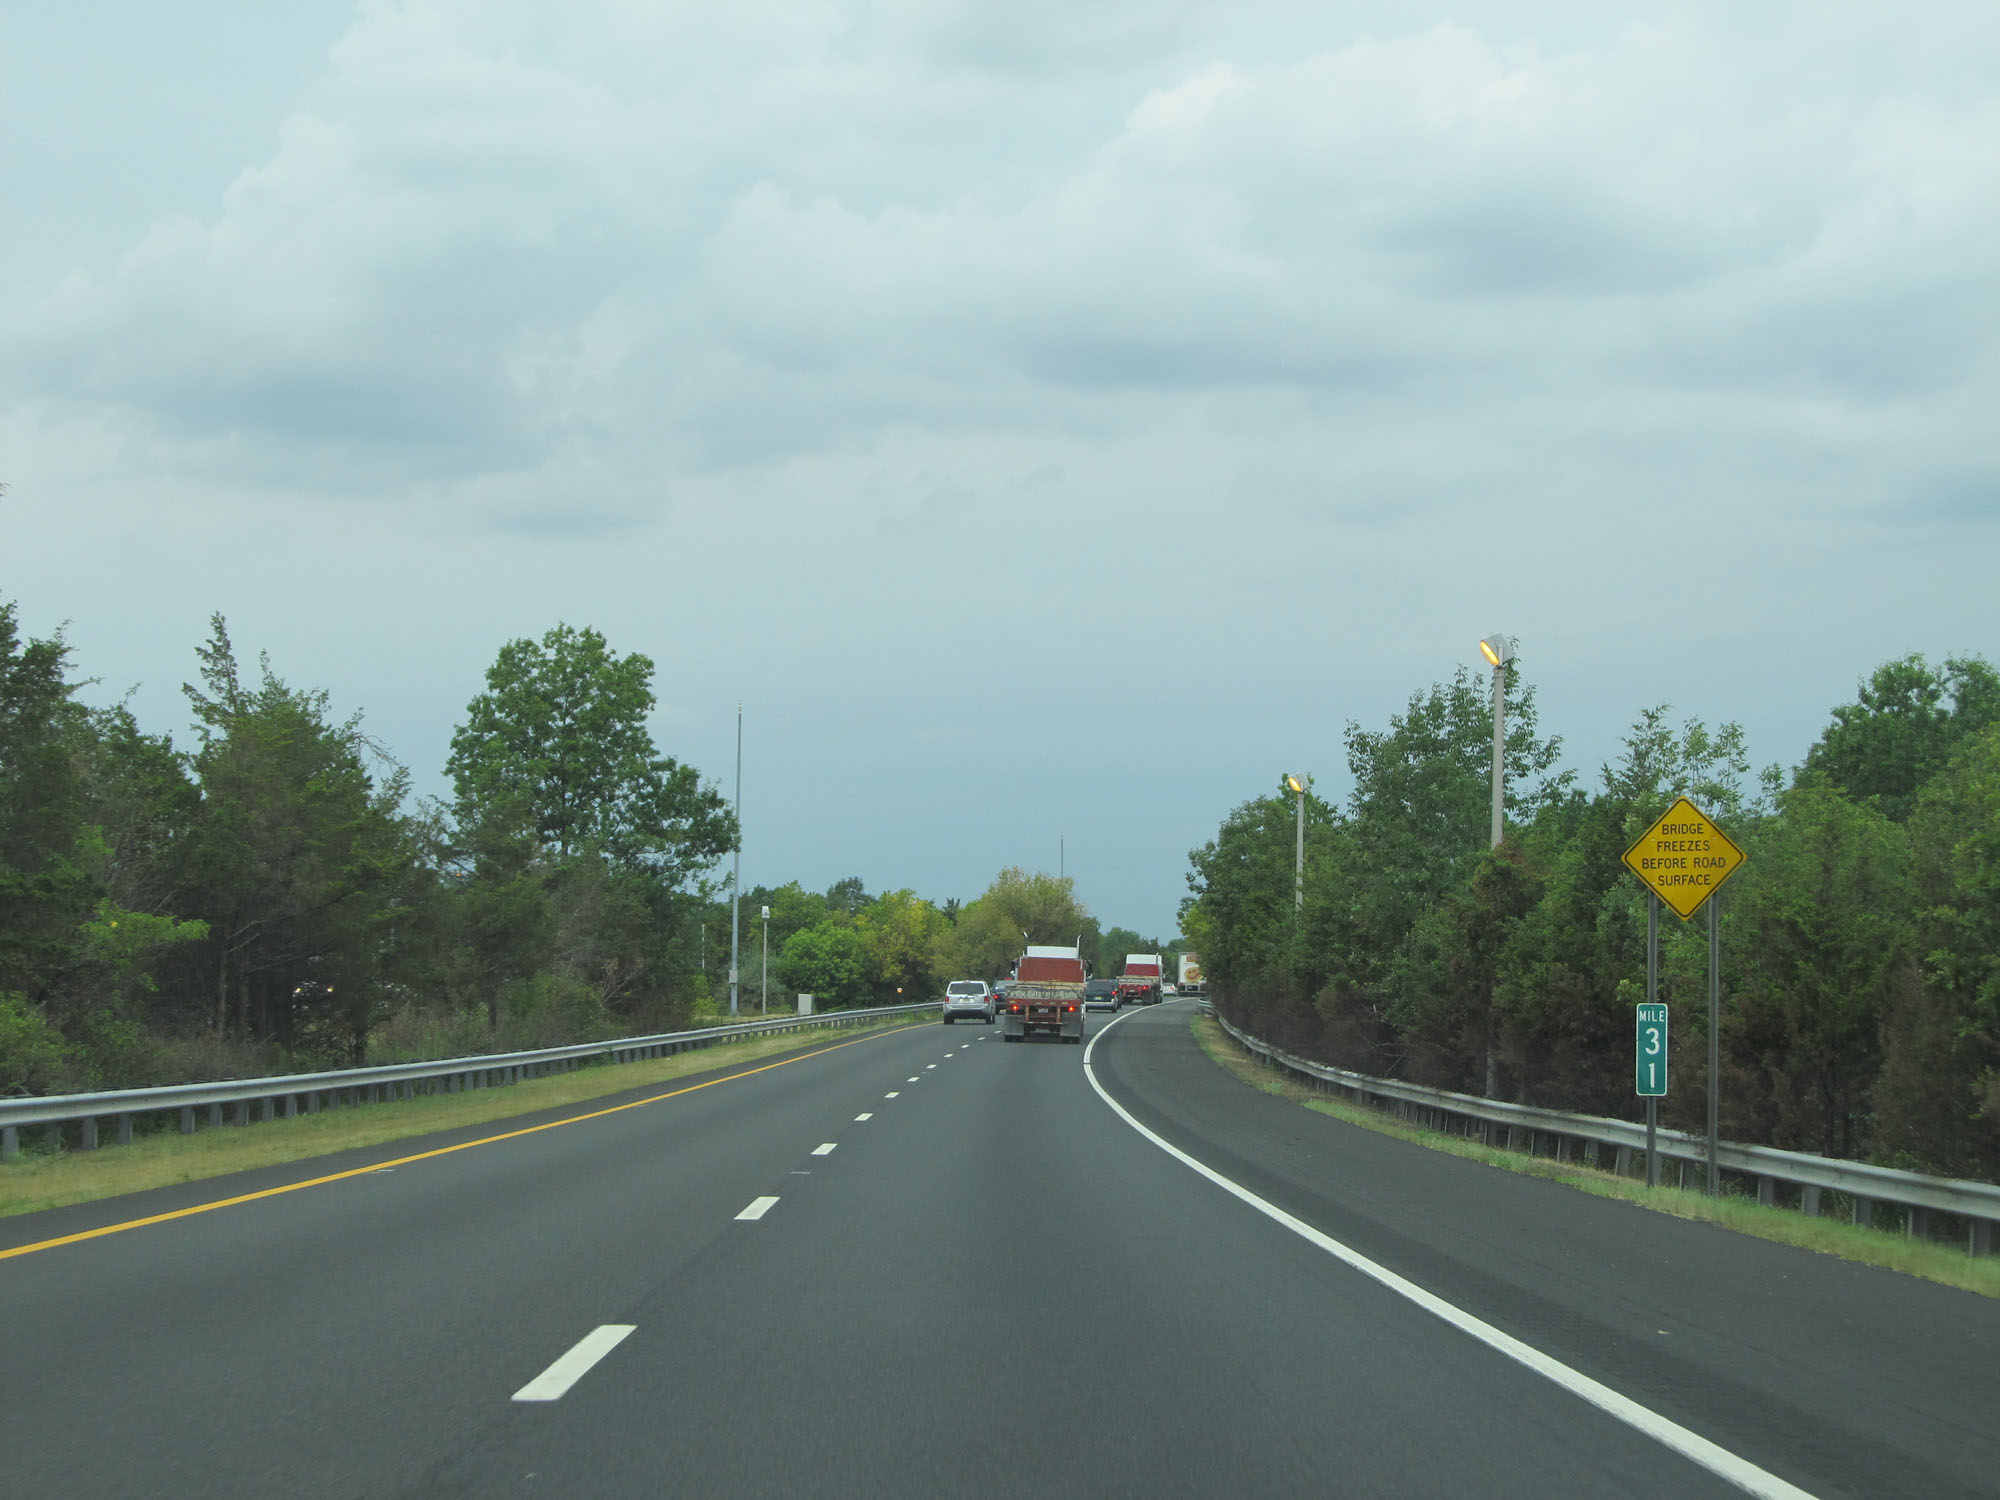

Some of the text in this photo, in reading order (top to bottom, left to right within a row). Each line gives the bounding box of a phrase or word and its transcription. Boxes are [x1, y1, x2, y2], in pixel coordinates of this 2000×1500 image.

[1662, 823, 1704, 835] BRIDGE
[1657, 840, 1711, 852] FREEZES
[1642, 857, 1726, 869] BEFORE ROAD
[1658, 874, 1711, 886] SURFACE
[1640, 1010, 1665, 1022] MILE
[1645, 1027, 1660, 1055] 3
[1648, 1062, 1655, 1088] 1
